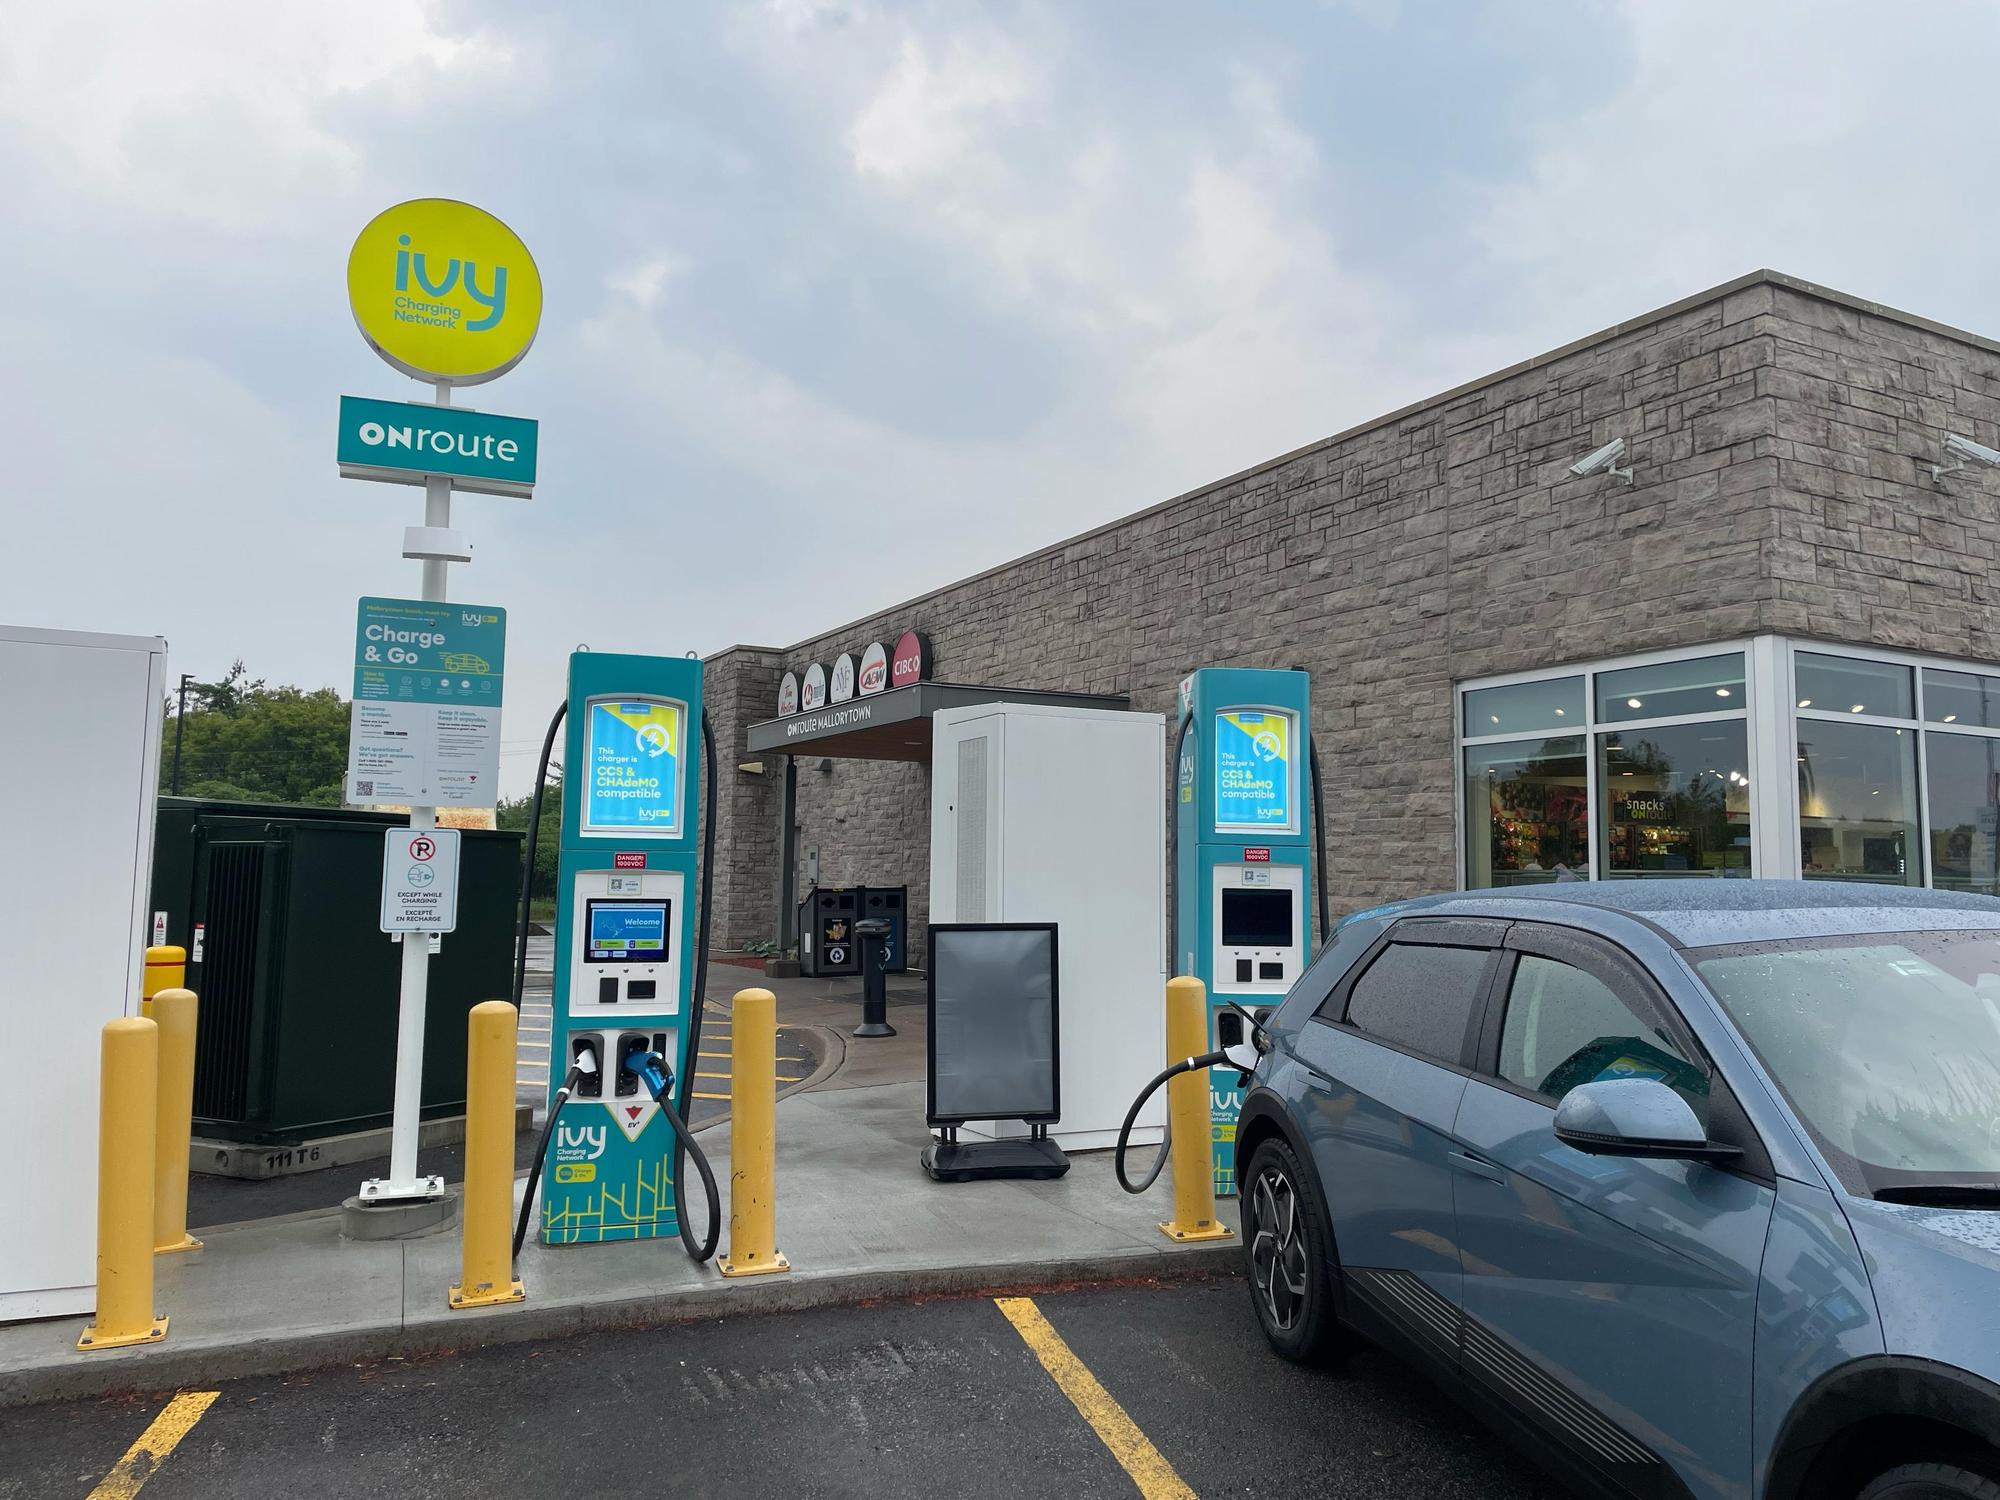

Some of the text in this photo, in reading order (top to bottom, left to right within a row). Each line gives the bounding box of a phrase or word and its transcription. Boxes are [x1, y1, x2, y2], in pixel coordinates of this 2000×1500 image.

[395, 234, 507, 332] ivy
[394, 296, 461, 319] Charging
[394, 309, 456, 329] Network
[359, 422, 519, 462] ONroute
[462, 610, 481, 626] ivy
[365, 624, 445, 648] Charge
[365, 645, 418, 664] & Go
[895, 657, 912, 676] CIBC
[864, 668, 885, 687] A&W
[787, 705, 871, 737] ONroute MALLORYTOWN
[598, 747, 614, 755] This
[597, 755, 638, 764] charger is
[1221, 760, 1248, 768] charger
[597, 766, 635, 777] CCS &
[1222, 770, 1243, 779] CCS
[596, 788, 662, 800] compatible
[1221, 790, 1276, 801] compatible
[1626, 798, 1665, 811] snacks
[639, 807, 656, 821] ivy
[624, 918, 660, 926] Welcome
[557, 1119, 606, 1160] ivy
[556, 1148, 587, 1156] Charging
